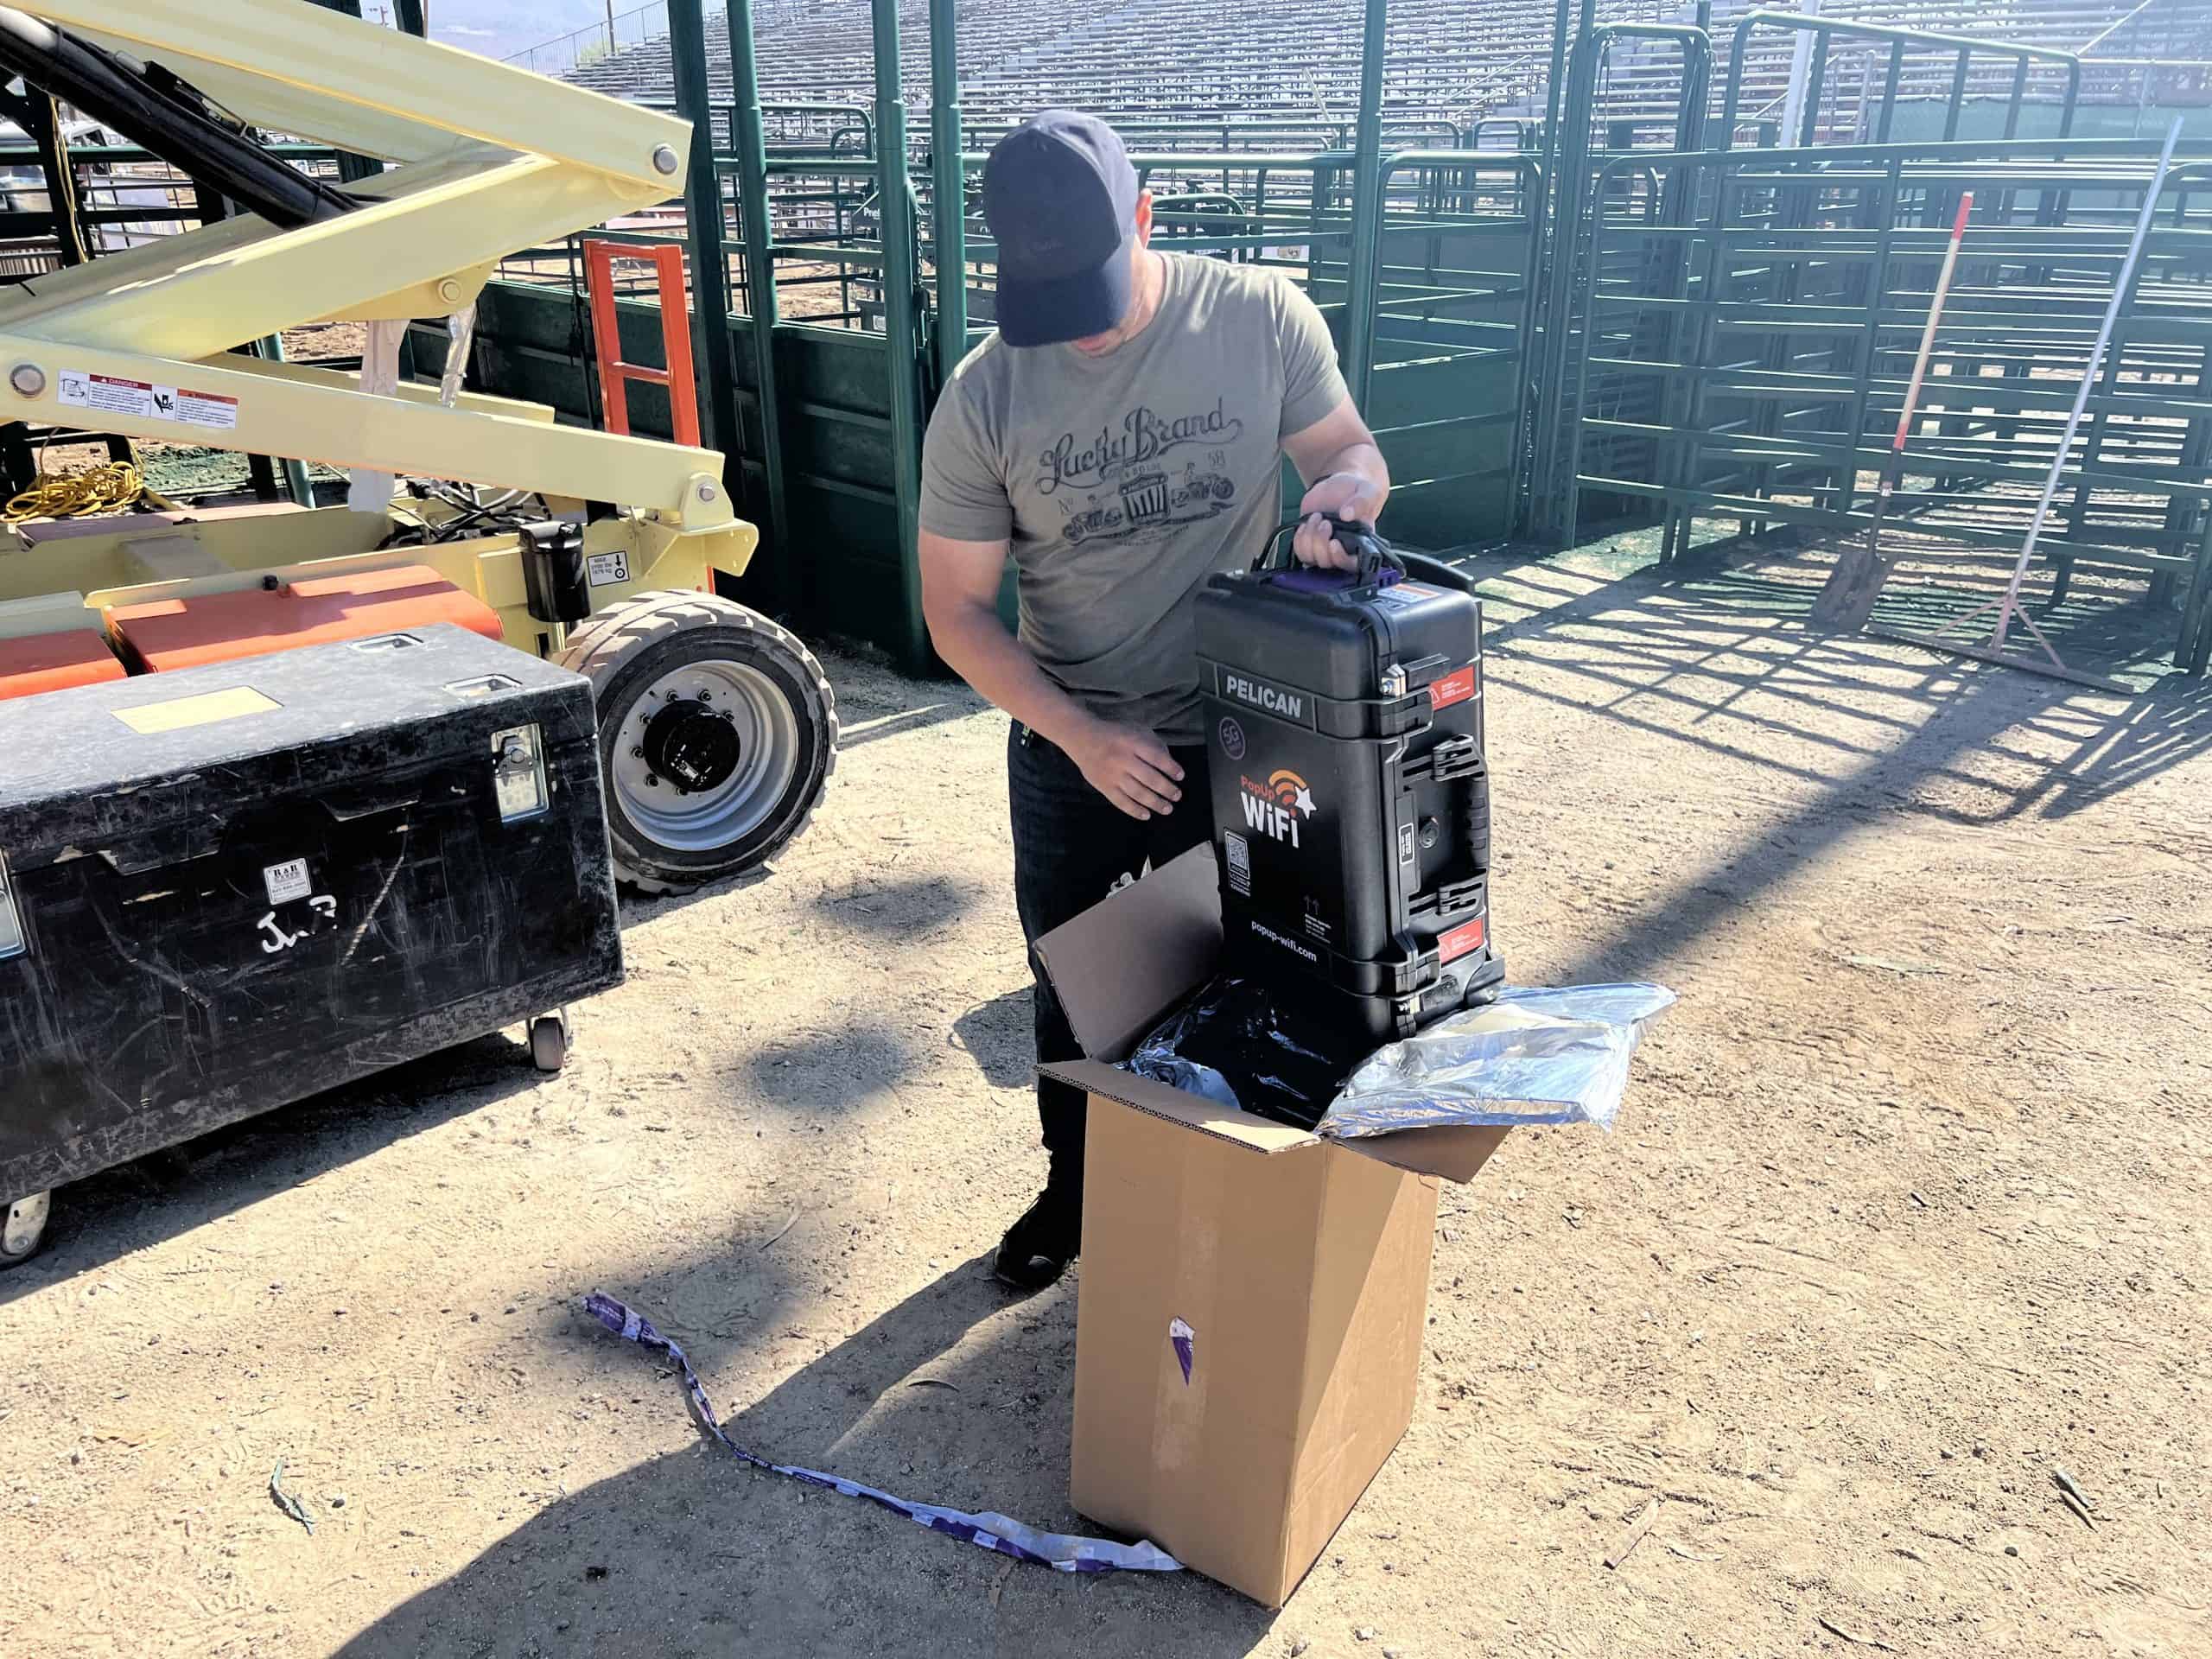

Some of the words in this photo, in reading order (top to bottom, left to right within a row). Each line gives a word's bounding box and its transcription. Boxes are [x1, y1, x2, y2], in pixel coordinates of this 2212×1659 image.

[1036, 426, 1128, 495] Lucky
[1125, 397, 1243, 464] Brand
[1227, 675, 1301, 718] PELICAN
[1223, 725, 1239, 743] 5G
[1241, 775, 1275, 801] PopUp
[1241, 791, 1300, 849] WiFi
[1251, 920, 1317, 962] popup-wifi.com
